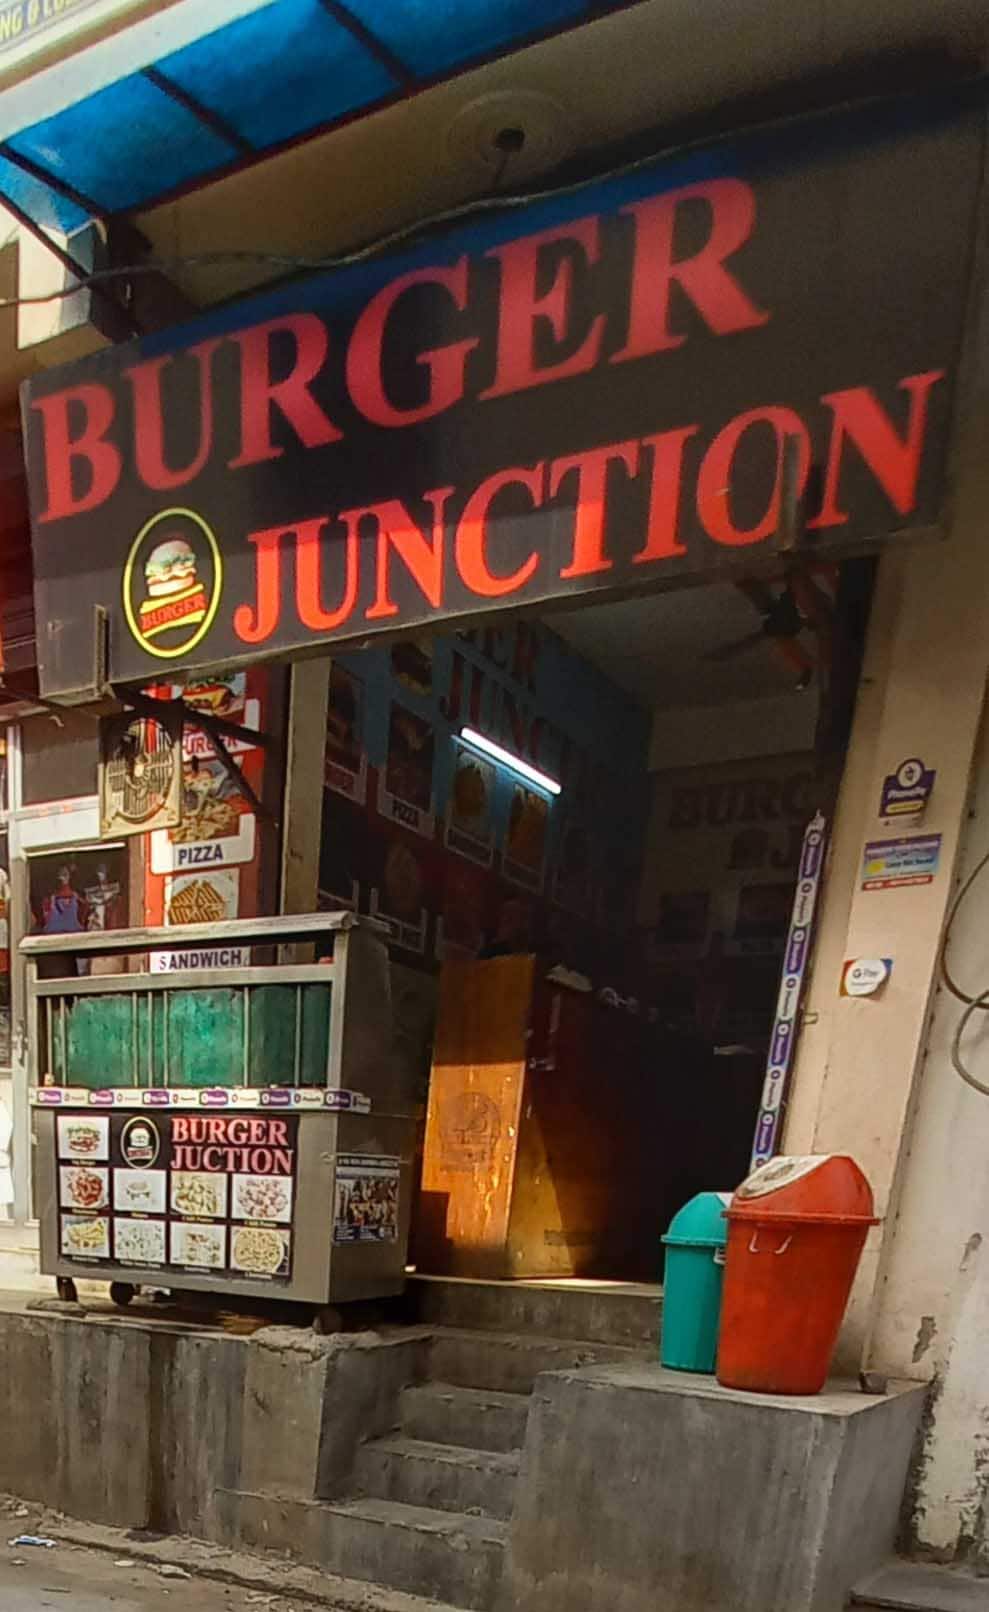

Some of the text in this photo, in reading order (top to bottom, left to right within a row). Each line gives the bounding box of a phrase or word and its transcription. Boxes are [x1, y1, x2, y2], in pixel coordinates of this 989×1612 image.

[32, 177, 771, 524] BURGER
[233, 369, 946, 644] JUNCTION
[177, 843, 224, 866] PIZZA
[158, 949, 243, 971] SANDWICH
[170, 1116, 289, 1146] BURGER
[170, 1148, 295, 1175] JUCTION
